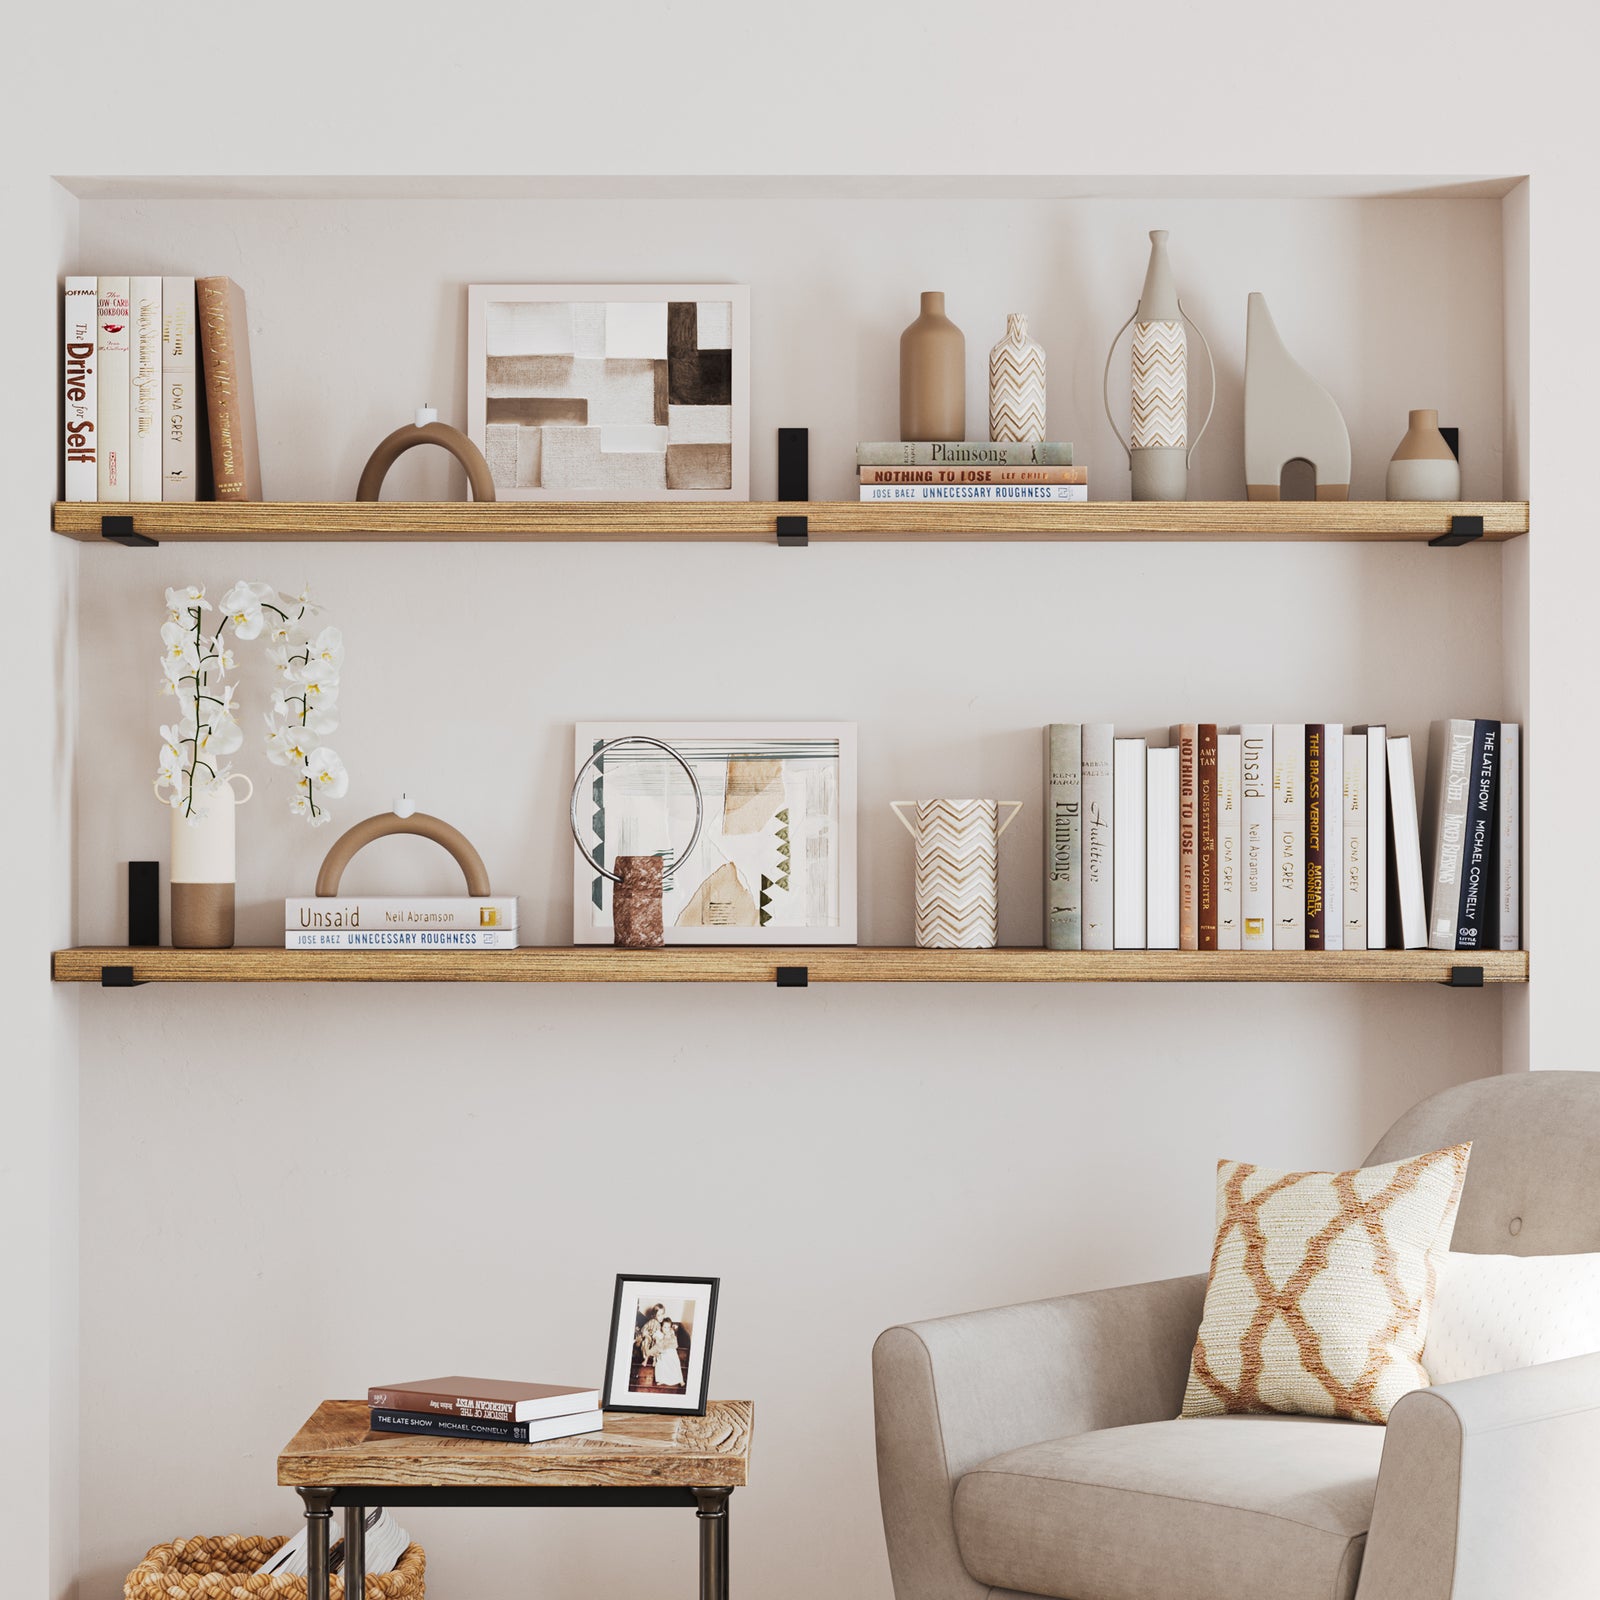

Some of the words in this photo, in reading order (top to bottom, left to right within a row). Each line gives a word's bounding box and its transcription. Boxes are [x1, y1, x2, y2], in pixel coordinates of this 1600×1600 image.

[75, 322, 88, 340] The
[66, 342, 95, 400] Drive
[171, 383, 184, 410] IONA
[71, 403, 88, 419] for
[66, 420, 96, 463] Self
[170, 414, 184, 442] GREY
[930, 443, 1008, 466] Plainsong
[874, 471, 933, 482] NOTHING
[938, 471, 955, 482] TO
[872, 489, 892, 499] JOSE
[895, 489, 916, 498] BAEZ
[922, 487, 992, 498] UNNECESSARY
[995, 487, 1052, 498] ROUGHNESS
[1200, 748, 1217, 756] AMY
[1309, 733, 1320, 757] THE
[1483, 731, 1496, 752] THE
[1181, 738, 1194, 797] NOTHING
[1200, 757, 1217, 766] TAN
[1243, 738, 1266, 799] Unsaid
[1480, 752, 1494, 778] LATE
[1309, 759, 1320, 799] BRASS
[1477, 778, 1491, 812] SHOW
[1181, 801, 1193, 819] TO
[1202, 779, 1211, 851] BONESETTER'S
[1248, 823, 1261, 842] Neil
[1309, 801, 1320, 852] VERDICT
[1050, 801, 1080, 883] Plainsong
[1089, 801, 1110, 883] Audition
[1223, 836, 1233, 863] IONA
[1282, 831, 1295, 858] IONA
[1350, 836, 1360, 863] IONA
[1471, 818, 1486, 865] MICHAEL
[1202, 853, 1211, 911] DAUGHTER
[1223, 866, 1233, 893] GREY
[1248, 845, 1261, 893] Abramson
[1281, 861, 1294, 890] GREY
[1349, 866, 1360, 893] GREY
[1306, 861, 1316, 918] CONNELLY
[1313, 864, 1323, 915] MICHAEL
[1465, 866, 1481, 920] CONNELLY
[300, 905, 360, 927] Unsaid
[385, 911, 404, 922] Neil
[407, 911, 455, 922] Abramson
[297, 935, 317, 945] JOSE
[320, 935, 341, 944] BAEZ
[347, 933, 417, 945] UNNECESSARY
[420, 933, 477, 944] ROUGHNESS
[455, 1398, 475, 1409] WEST
[475, 1400, 514, 1413] AMERICAN
[377, 1415, 391, 1424] THE
[392, 1417, 410, 1426] LATE
[410, 1418, 433, 1428] SHOW
[438, 1421, 470, 1431] MICHAEL
[471, 1424, 508, 1435] CONNELLY
